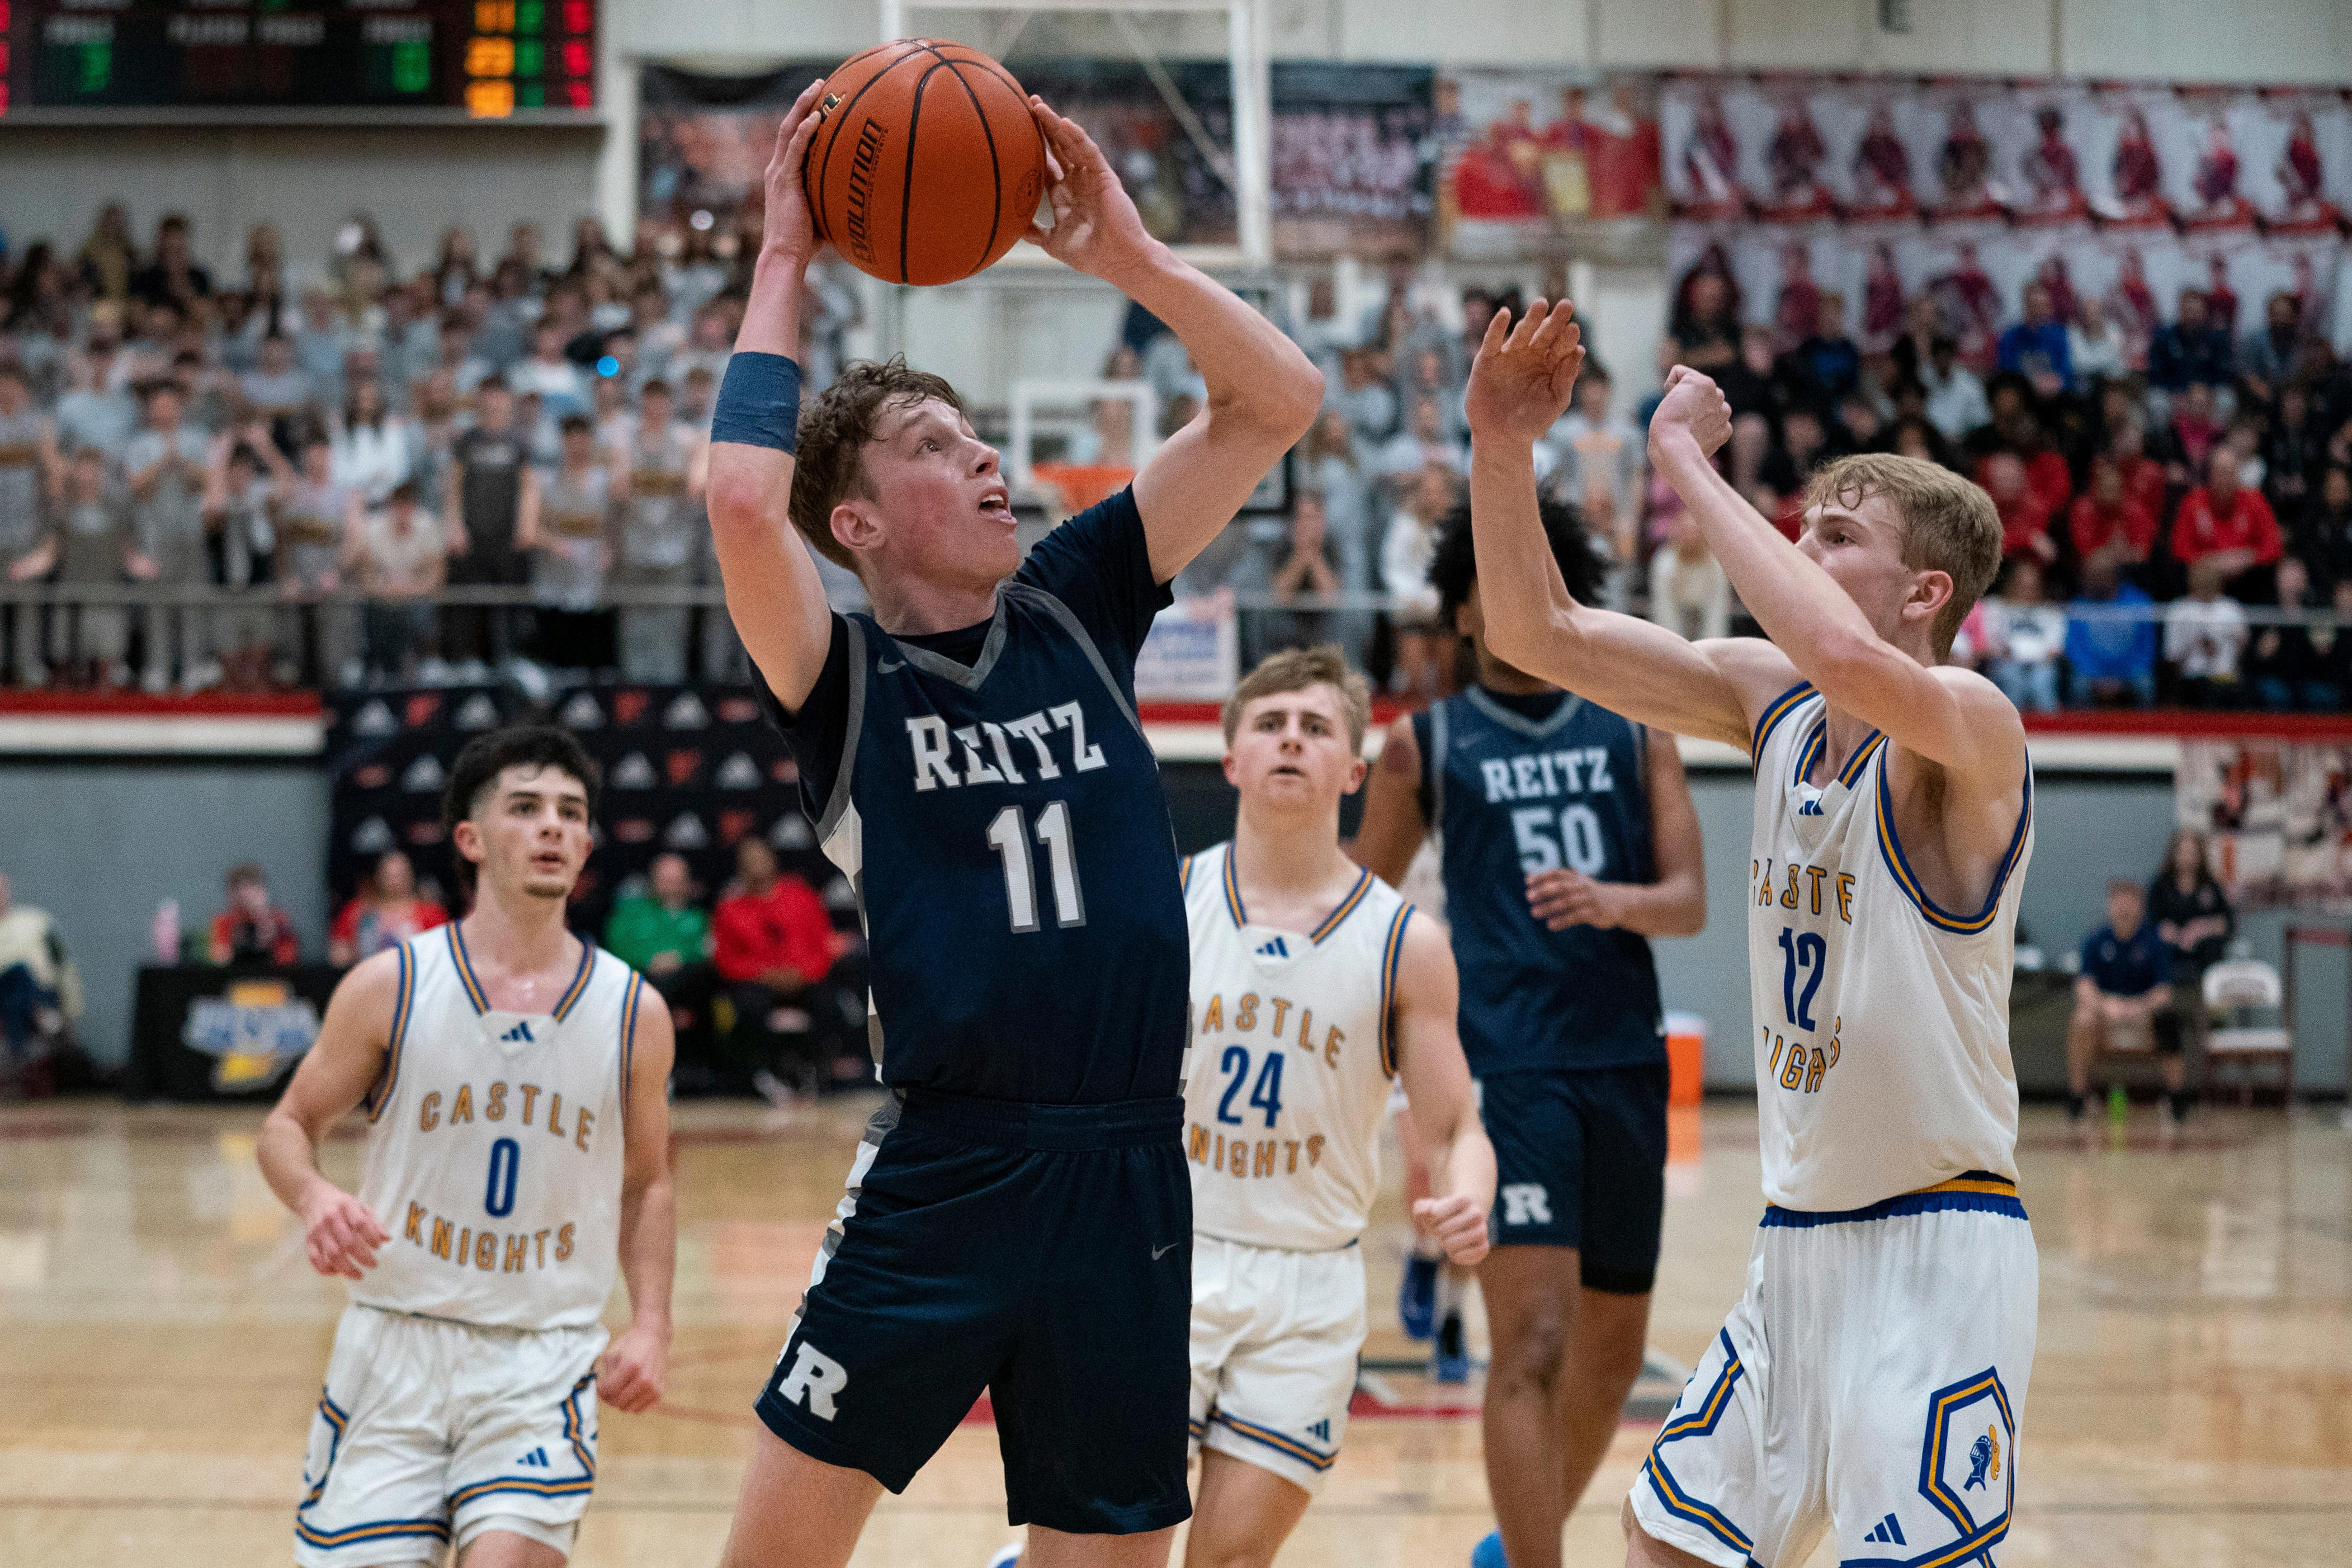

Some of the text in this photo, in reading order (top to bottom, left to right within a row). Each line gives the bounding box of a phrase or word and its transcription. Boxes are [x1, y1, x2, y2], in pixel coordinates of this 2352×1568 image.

[848, 117, 882, 265] EVOLUTION
[905, 700, 1108, 792] REITZ
[1480, 746, 1614, 804] REITZ
[986, 800, 1087, 933] 11
[1512, 803, 1605, 875] 50
[1779, 927, 1827, 1033] 12
[1202, 993, 1345, 1070] ASTLE
[420, 1081, 595, 1153] CASTLE
[1216, 1045, 1285, 1128] 24
[485, 1137, 520, 1218] 0
[1189, 1122, 1325, 1178] NIGHTS
[405, 1202, 576, 1273] KNIGHTS
[1501, 1183, 1552, 1225] R
[778, 1340, 848, 1422] R
